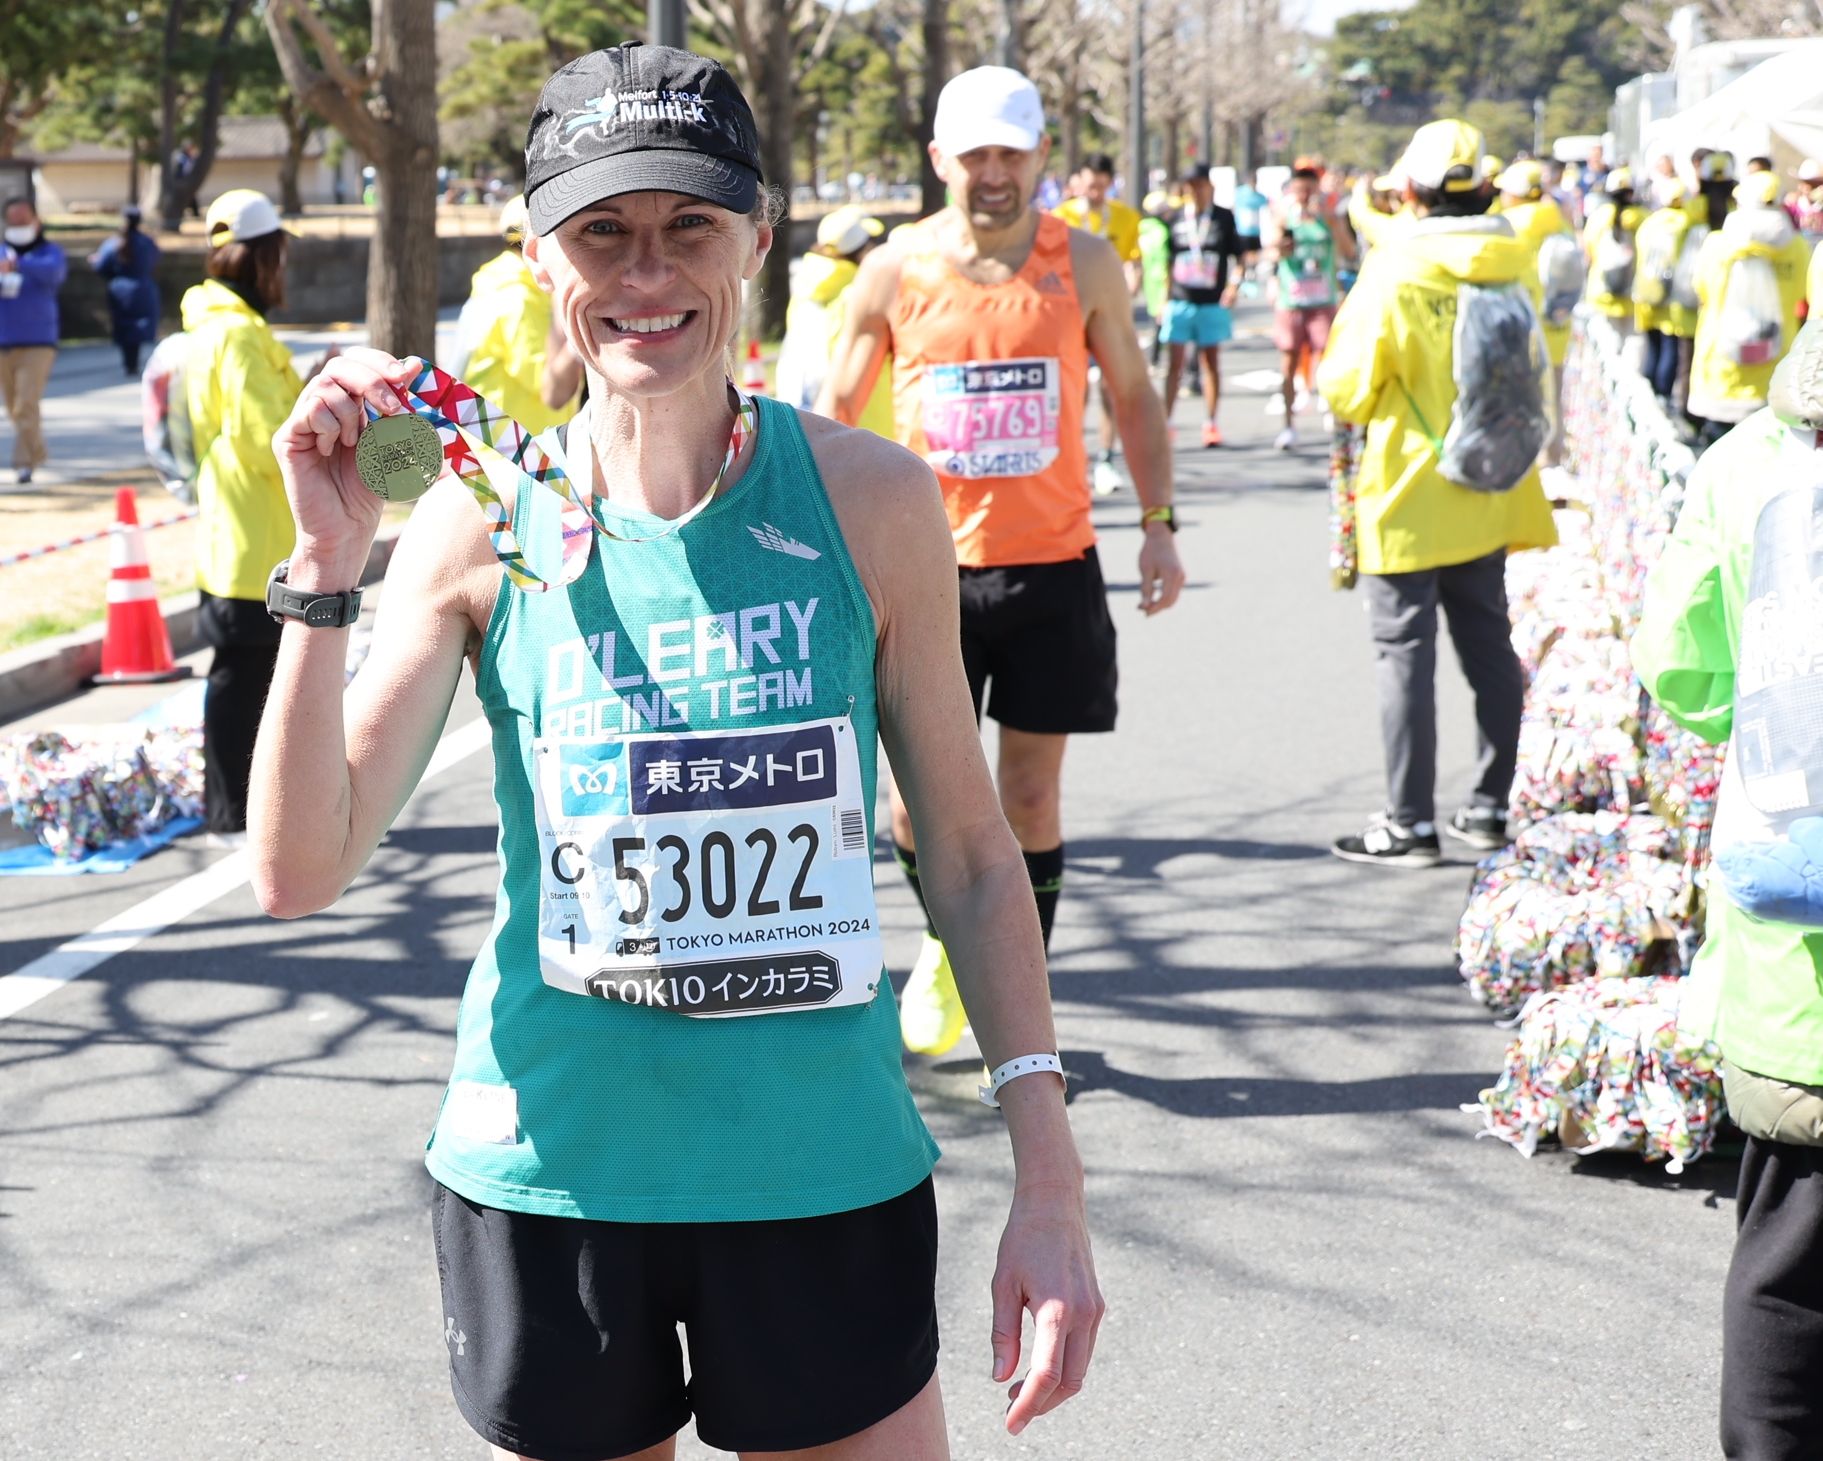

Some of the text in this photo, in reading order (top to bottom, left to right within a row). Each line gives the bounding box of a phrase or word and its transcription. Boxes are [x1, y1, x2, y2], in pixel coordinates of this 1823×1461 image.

[617, 89, 658, 102] Melfort
[952, 397, 1043, 441] 75769
[383, 456, 418, 474] 2024
[544, 597, 820, 706] O'LEARY
[541, 666, 813, 737] RACING TEAM
[644, 747, 826, 796] 東京メトロ
[550, 841, 586, 885] C
[611, 823, 824, 926] 53022
[549, 891, 591, 900] Start 0910
[561, 923, 577, 956] 1
[666, 918, 871, 951] TOKYO MARATHON 2024
[593, 963, 835, 1007] TOKIO インカラミ
